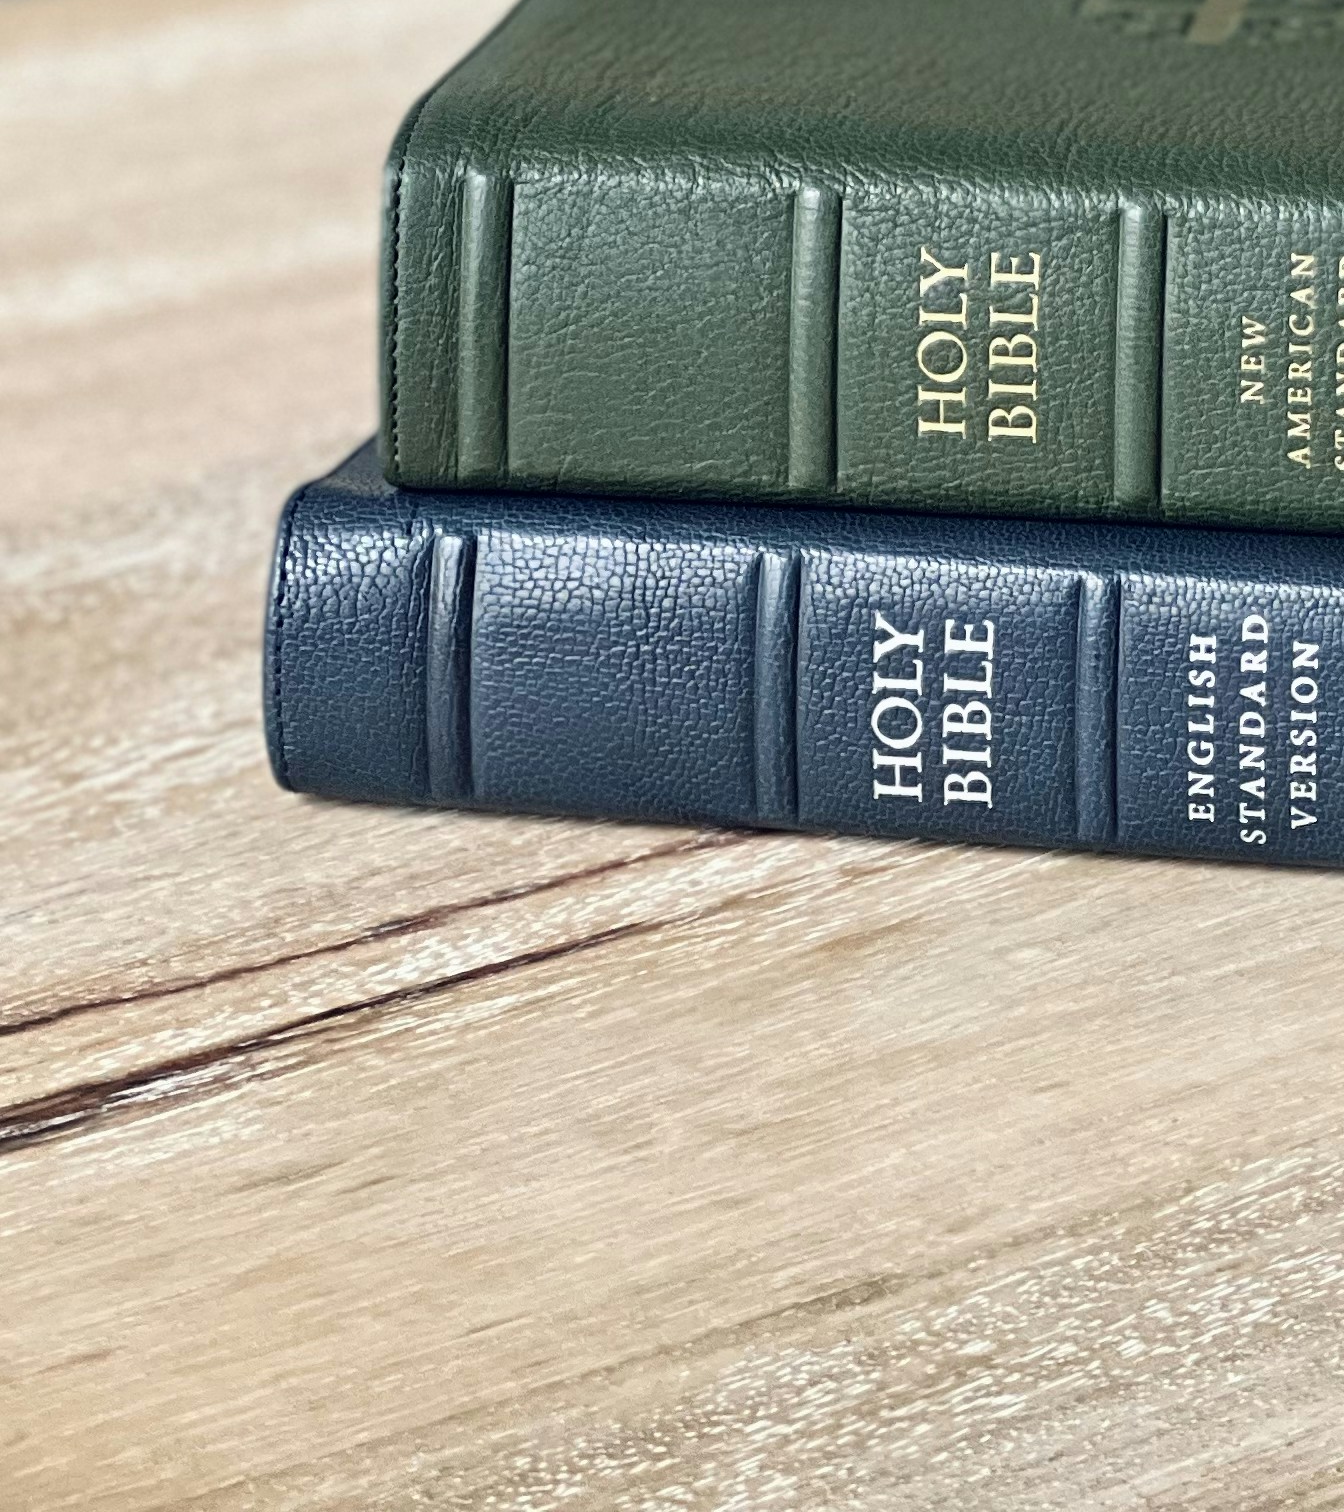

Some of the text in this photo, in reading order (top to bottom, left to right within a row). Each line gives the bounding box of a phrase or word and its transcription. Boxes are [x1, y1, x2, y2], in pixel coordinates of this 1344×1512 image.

[917, 246, 968, 440] HOLY
[987, 251, 1041, 444] BIBLE
[1240, 315, 1267, 405] NEW
[1286, 252, 1317, 470] AMERICAN
[871, 610, 925, 803] HOLY
[942, 618, 995, 809] BIBLE
[1188, 633, 1217, 823] ENGLISH
[1238, 613, 1269, 845] STANDARD
[1290, 640, 1320, 829] VERSION
